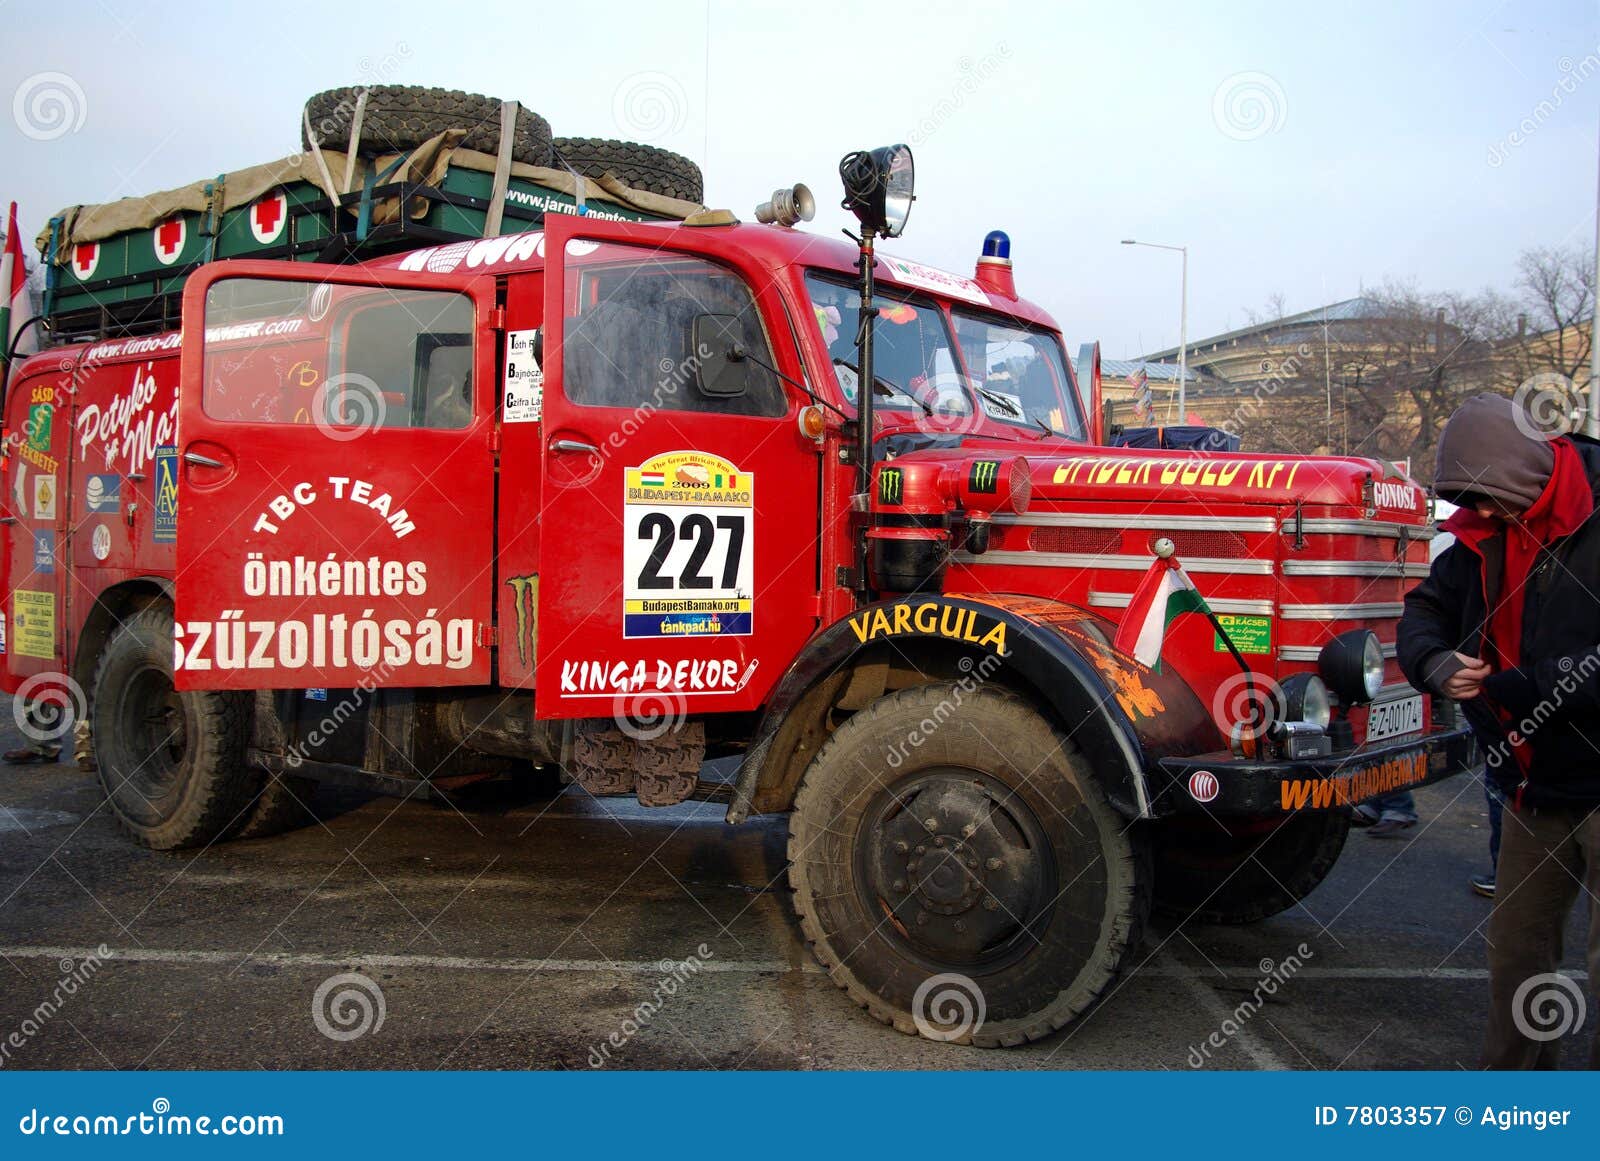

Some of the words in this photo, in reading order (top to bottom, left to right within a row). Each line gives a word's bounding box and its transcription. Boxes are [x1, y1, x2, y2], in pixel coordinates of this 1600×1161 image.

[668, 456, 688, 464] Great
[628, 486, 750, 503] BUDAPEST-BAMAKO
[672, 481, 710, 489] 2009
[1373, 481, 1417, 510] GONOSZ
[253, 482, 318, 536] TBC
[328, 476, 416, 539] TEAM
[637, 512, 745, 590] 227
[243, 551, 428, 597] önkéntes
[642, 600, 740, 613] BudapestBamako.org
[660, 619, 721, 636] tankpad.hu
[848, 602, 1008, 657] VARGULA
[560, 658, 648, 693] KINGA
[655, 658, 739, 691] DEKOR
